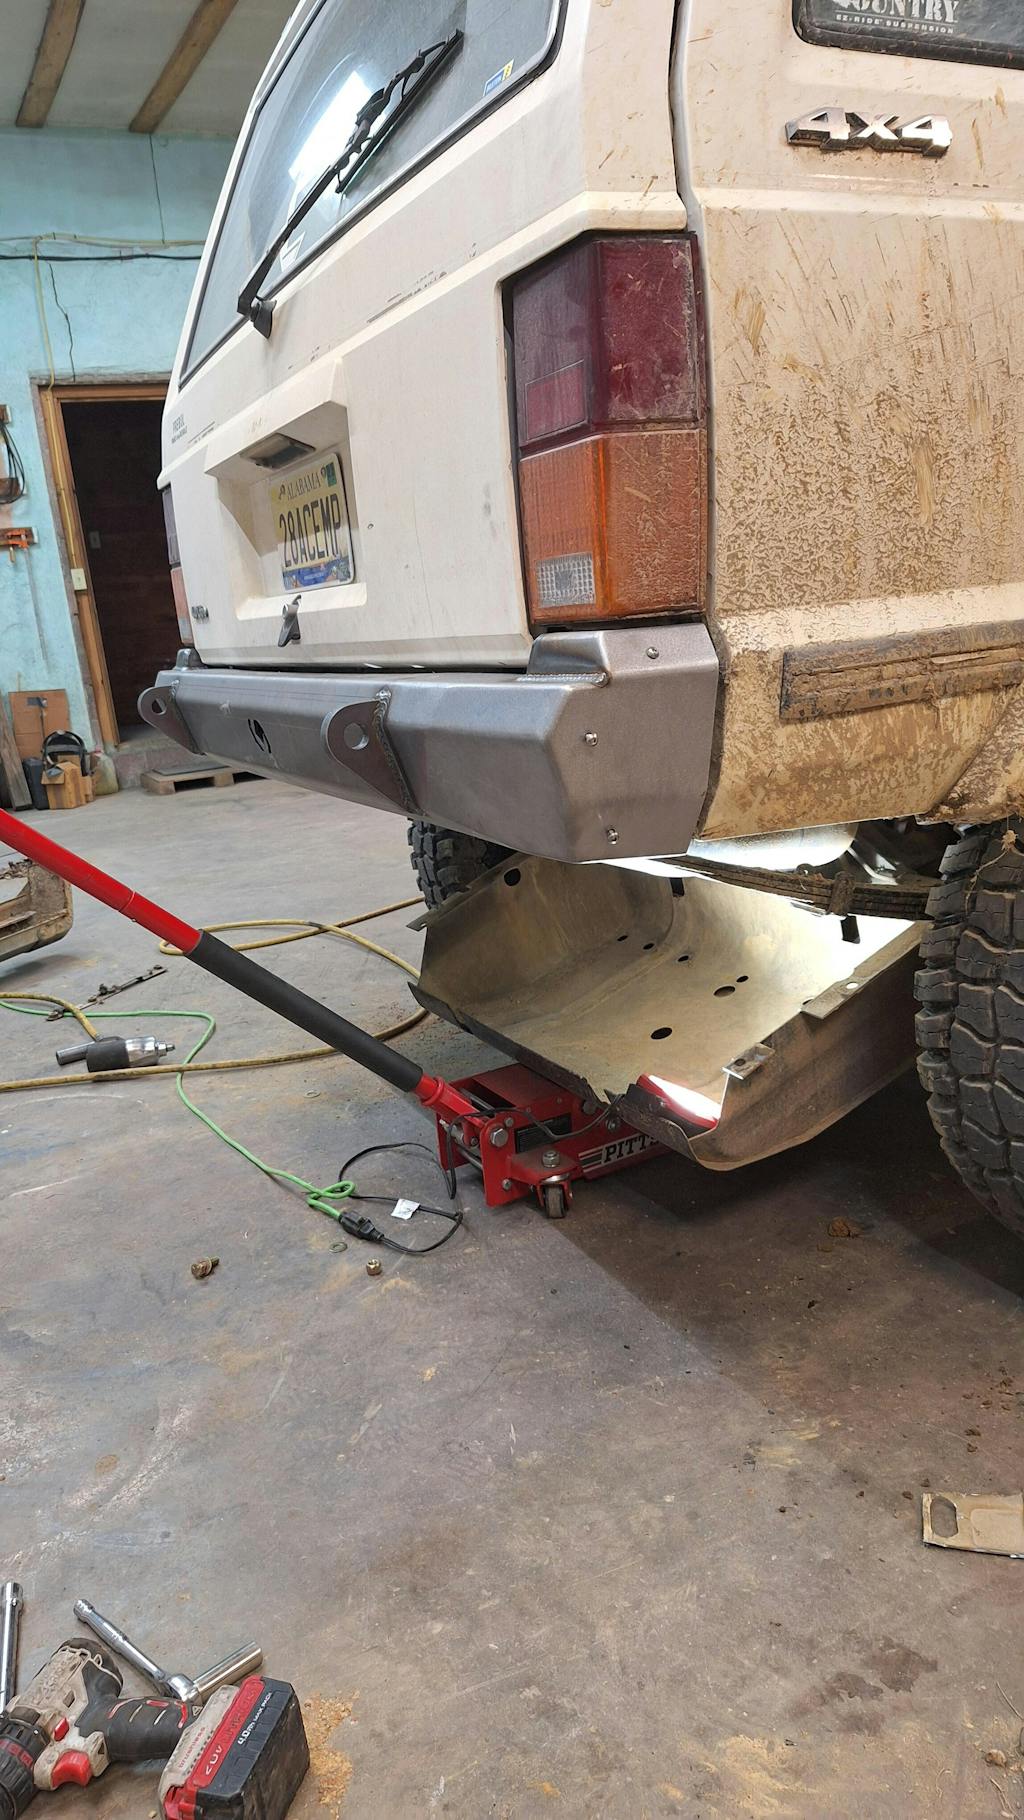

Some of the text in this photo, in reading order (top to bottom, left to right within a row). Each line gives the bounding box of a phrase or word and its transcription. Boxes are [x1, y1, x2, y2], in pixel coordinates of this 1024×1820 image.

[886, 20, 954, 34] SUSPENSION
[287, 471, 321, 501] ALABAMA
[279, 493, 341, 568] 28ACEMP
